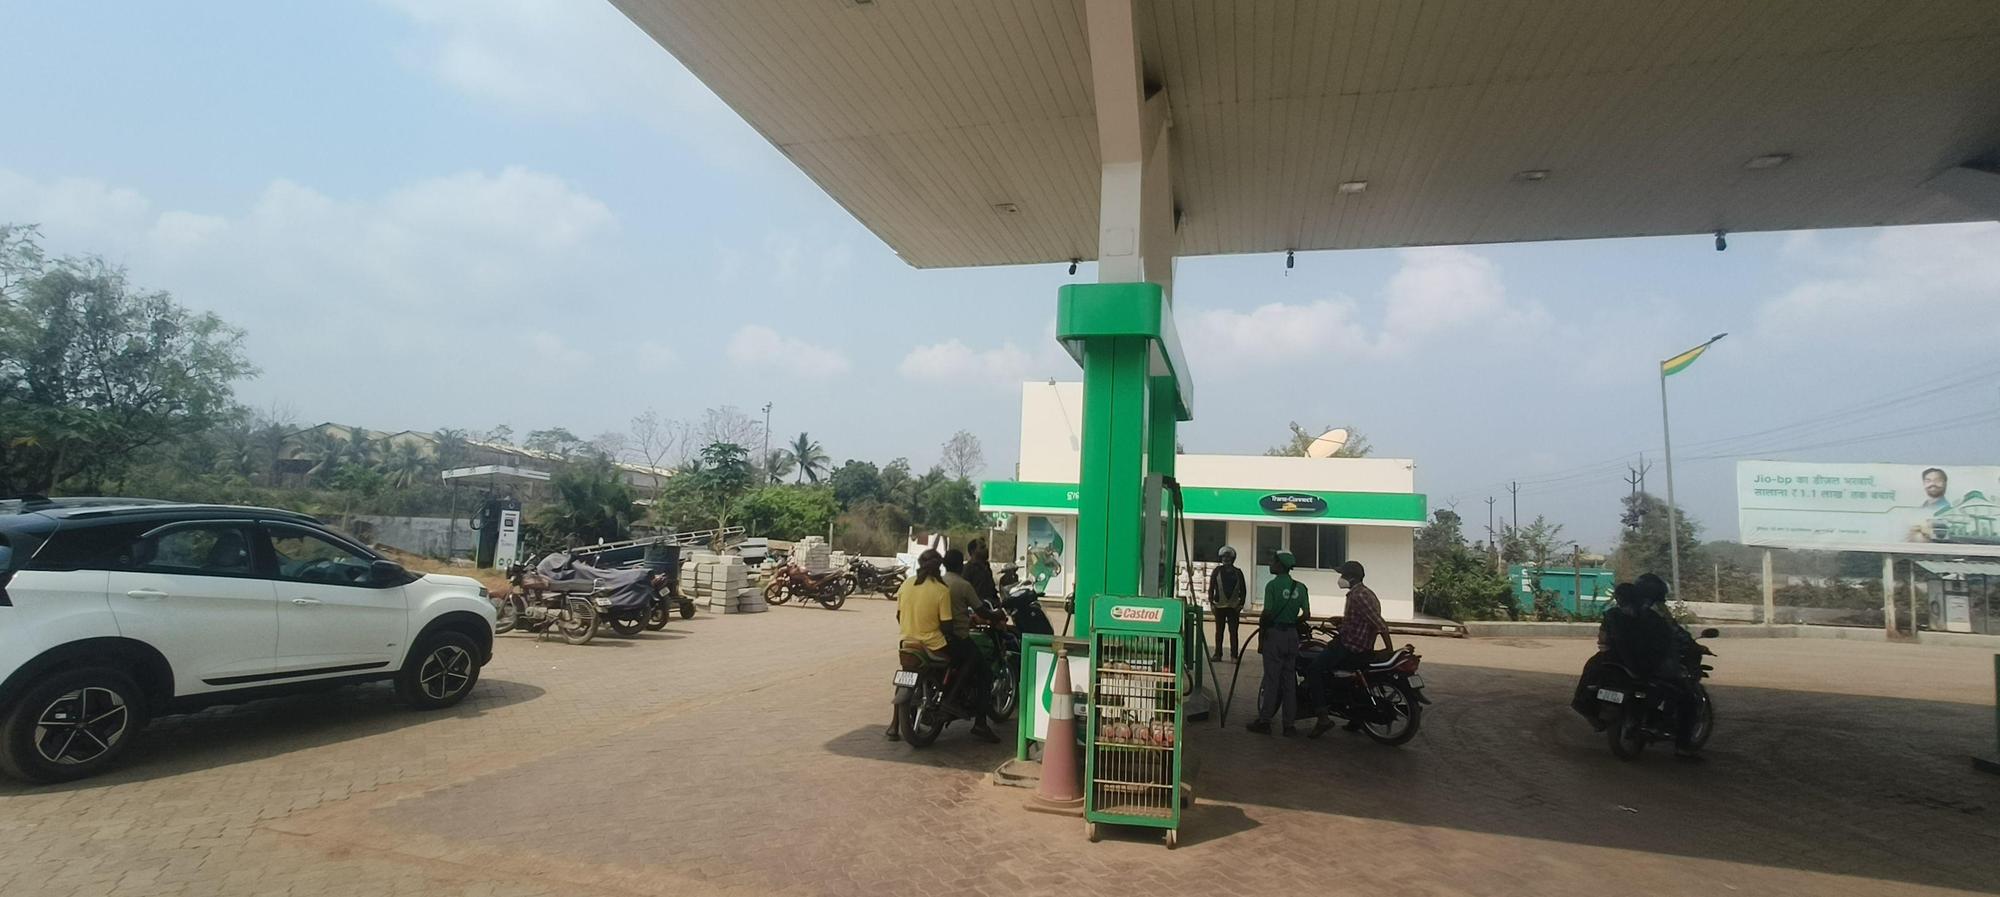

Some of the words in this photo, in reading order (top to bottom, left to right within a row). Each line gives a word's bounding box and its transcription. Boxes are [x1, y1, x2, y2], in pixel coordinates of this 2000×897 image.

[1754, 475, 1792, 485] Jio-bp
[1271, 495, 1313, 503] Trans-Connect
[1123, 608, 1160, 620] Castrol
